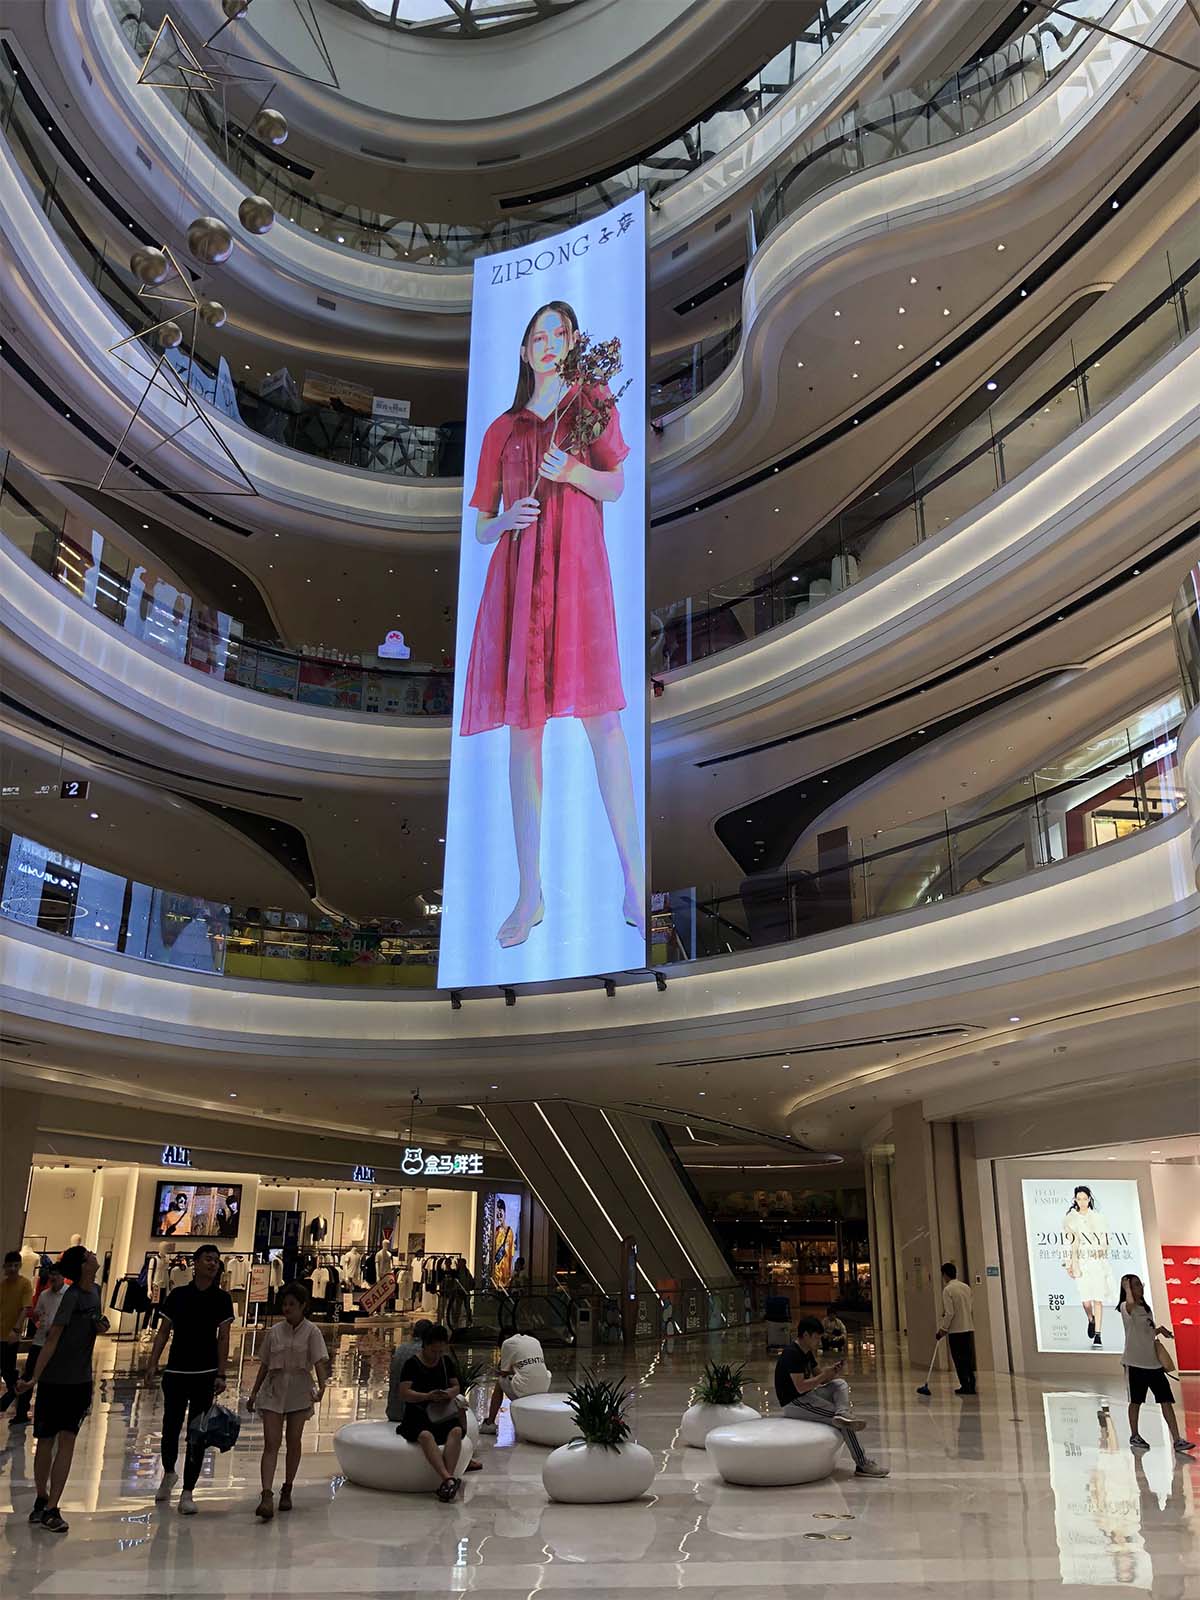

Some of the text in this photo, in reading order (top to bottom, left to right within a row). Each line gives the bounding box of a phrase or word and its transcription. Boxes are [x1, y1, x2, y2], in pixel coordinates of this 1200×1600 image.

[491, 233, 590, 285] ZIRONG
[424, 1154, 483, 1175] 盒马鲜生
[1036, 1232, 1131, 1246] 2019 NYFW
[364, 1281, 390, 1309] SALE
